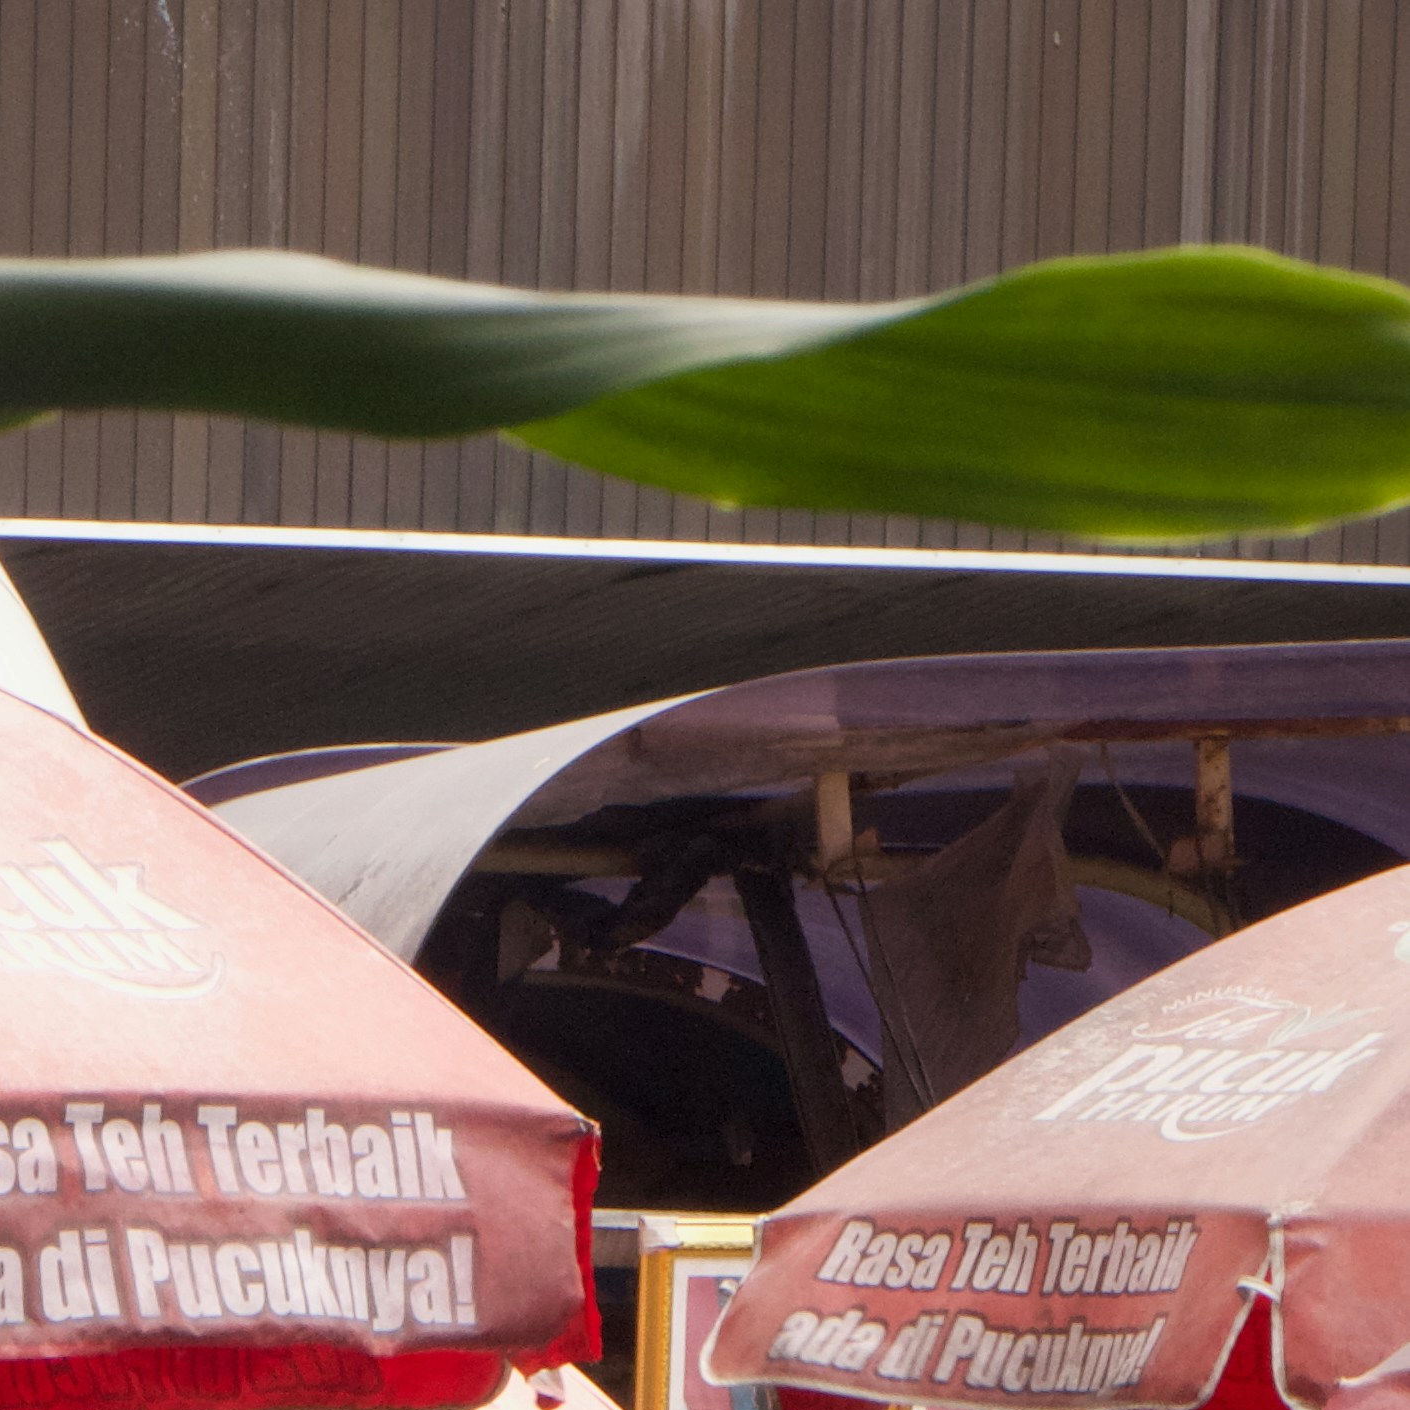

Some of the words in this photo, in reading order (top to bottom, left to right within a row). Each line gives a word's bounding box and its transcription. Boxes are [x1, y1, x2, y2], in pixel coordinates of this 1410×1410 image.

[1130, 995, 1296, 1040] Teh
[1032, 1032, 1386, 1122] pucuk
[1077, 1093, 1298, 1132] HARUM
[65, 1102, 190, 1195] Teh
[198, 1104, 466, 1200] Terbaik
[40, 1229, 121, 1320] di
[127, 1228, 478, 1333] Pucuknya!
[817, 1219, 953, 1288] Rasa
[951, 1221, 1040, 1293] Teh
[1042, 1220, 1198, 1294] Terbaik
[768, 1309, 887, 1371] ada
[877, 1314, 947, 1381] di
[933, 1314, 1167, 1397] Pucuknya!
